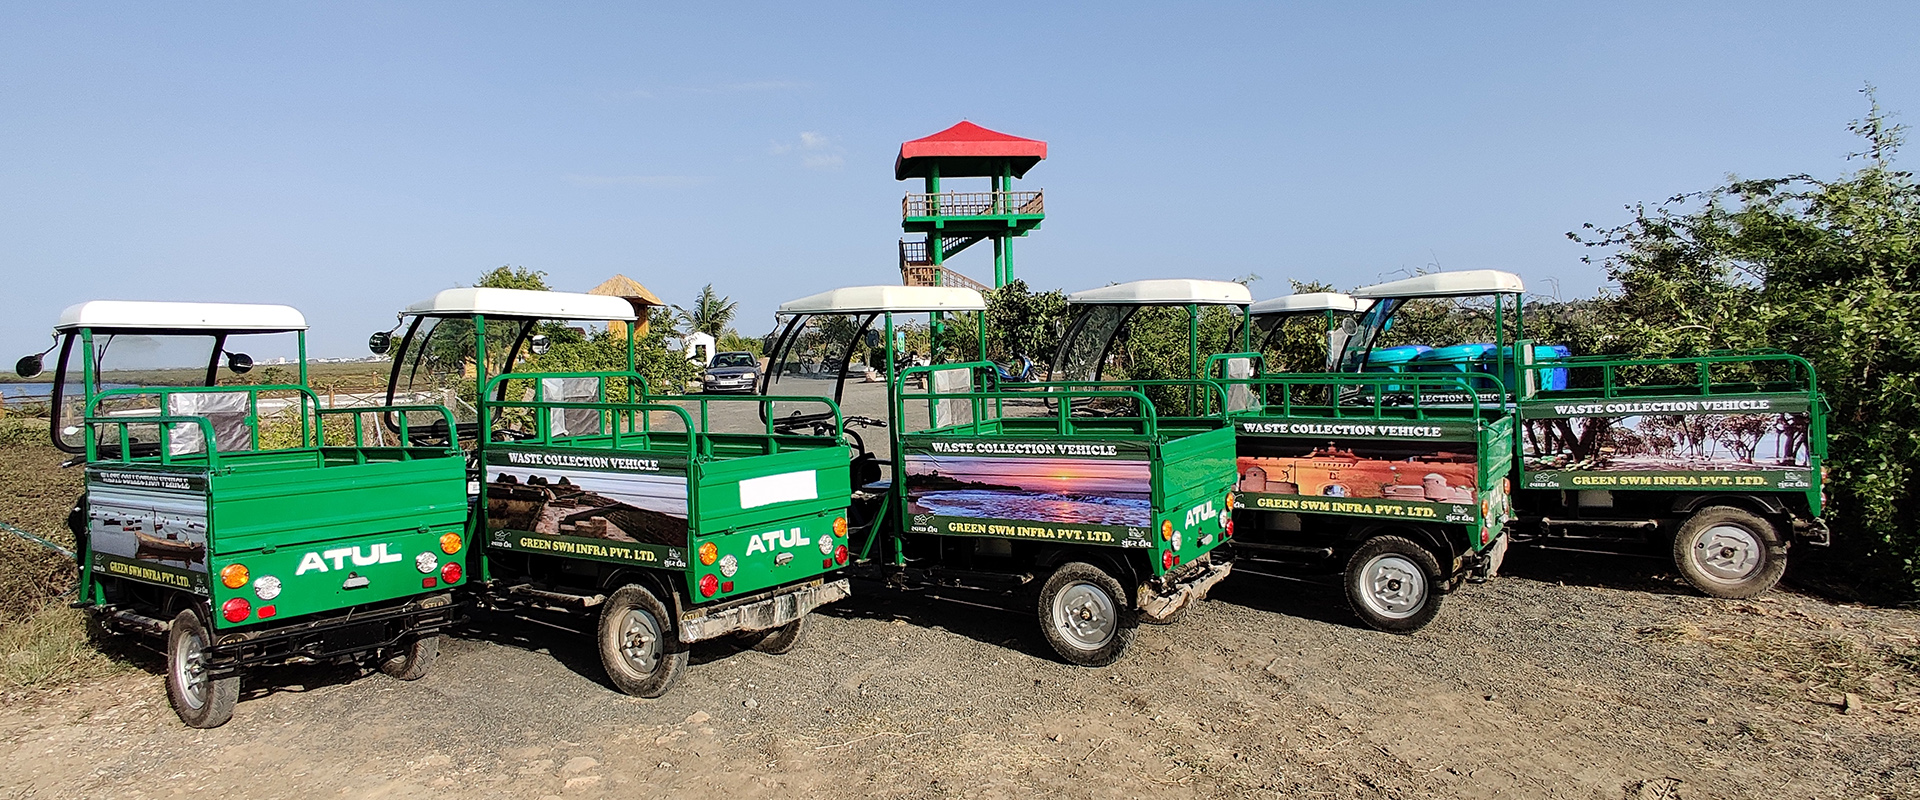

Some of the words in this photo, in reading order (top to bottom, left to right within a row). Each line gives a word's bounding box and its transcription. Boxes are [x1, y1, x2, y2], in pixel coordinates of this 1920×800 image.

[1554, 404, 1603, 415] WASTE
[1606, 402, 1697, 413] COLLECTION
[1701, 399, 1770, 411] VEHICLE
[1243, 423, 1288, 434] WASTE
[1290, 424, 1376, 436] COLLECTION
[1378, 426, 1442, 438] VEHICLE
[932, 442, 974, 453] WASTE
[977, 443, 1057, 455] COLLECTION
[1060, 445, 1117, 456] VEHICLE
[508, 452, 542, 464] WASTE
[543, 455, 608, 469] COLLECTION
[611, 459, 659, 471] VEHICLE
[1572, 476, 1615, 485] GREEN
[1619, 476, 1651, 485] SWM
[1653, 476, 1698, 485] INFRA
[1700, 476, 1733, 486] PVT.
[1735, 475, 1768, 485] LTD.
[1184, 500, 1217, 530] ATUL
[1257, 498, 1299, 509] GREEN
[1300, 500, 1330, 511] SWM
[1332, 502, 1373, 514] INFRA
[1375, 505, 1405, 516] PVT.
[1407, 507, 1437, 518] LTD.
[746, 527, 810, 556] ATUL
[948, 522, 986, 534] GREEN
[988, 525, 1015, 536] SWM
[1017, 527, 1055, 539] INFRA
[1057, 530, 1085, 541] PVT.
[1087, 531, 1116, 543] LTD.
[295, 543, 402, 576] ATUL
[520, 537, 551, 550] GREEN
[552, 541, 575, 553] SWM
[576, 544, 608, 557] INFRA
[609, 548, 633, 560] PVT.
[635, 550, 657, 562] LTD.
[109, 561, 128, 574] GREEN
[128, 565, 142, 577] SWM
[142, 568, 162, 582] INFRA
[161, 573, 176, 585] PVT.
[176, 575, 191, 588] LTD.
